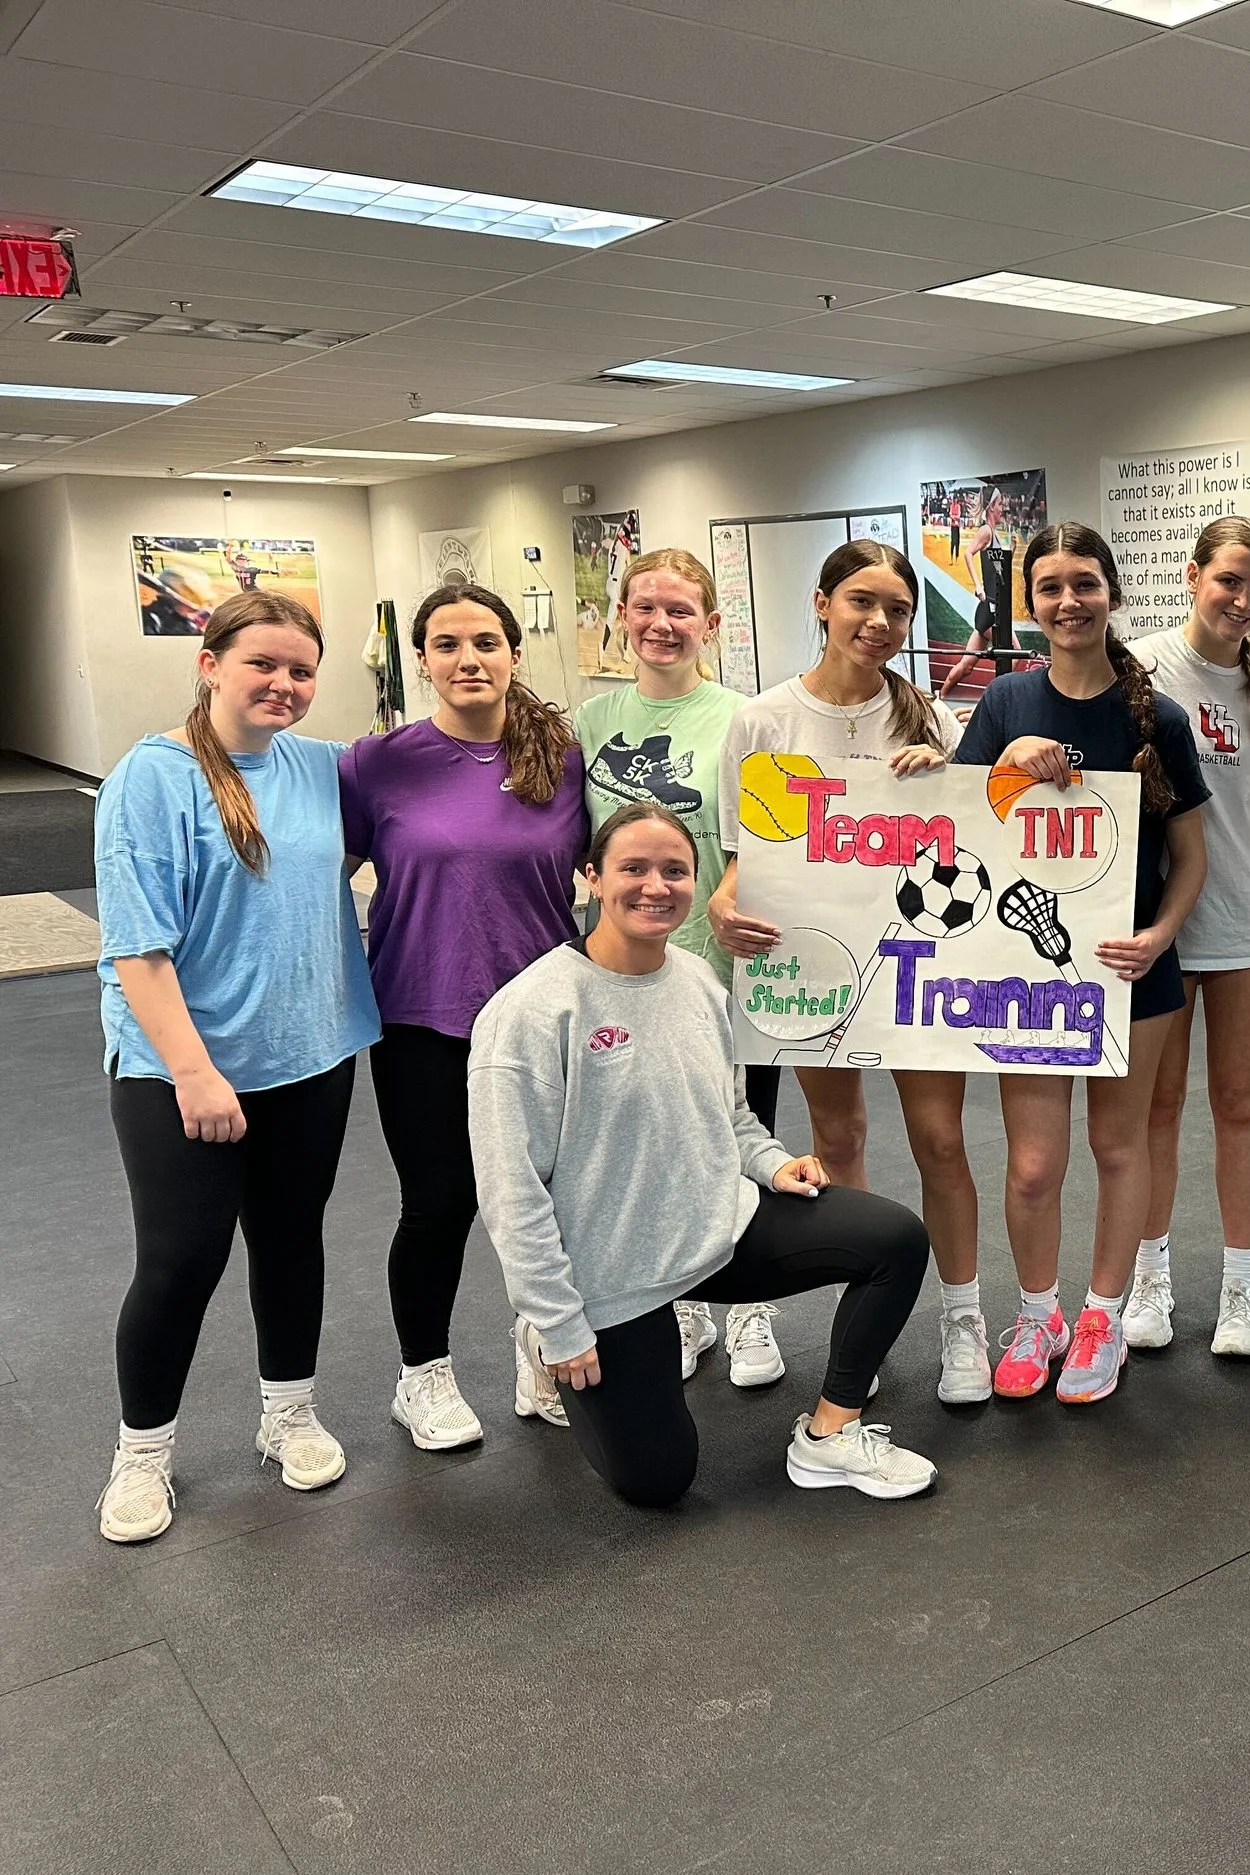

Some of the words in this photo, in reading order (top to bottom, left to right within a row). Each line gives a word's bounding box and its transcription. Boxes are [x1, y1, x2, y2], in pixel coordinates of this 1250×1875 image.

[1118, 462, 1149, 479] What
[1153, 458, 1175, 476] this
[1179, 456, 1218, 477] power
[1222, 453, 1232, 469] is
[1236, 451, 1239, 467] I
[1108, 484, 1148, 501] cannot
[1152, 484, 1174, 500] say;
[1178, 478, 1192, 495] all
[1196, 478, 1199, 494] I
[1203, 476, 1238, 493] know
[1123, 506, 1147, 522] that
[1150, 505, 1158, 521] it
[1162, 503, 1195, 520] exists
[1199, 498, 1222, 516] and
[1227, 499, 1235, 515] it
[1111, 528, 1162, 544] becomes
[1166, 523, 1205, 541] availa
[987, 549, 1005, 560] R12
[1116, 549, 1147, 565] when
[1151, 553, 1158, 564] a
[1161, 551, 1187, 563] man
[1137, 569, 1149, 585] of
[1153, 568, 1182, 585] mind
[1154, 591, 1195, 609] exactly
[1130, 613, 1164, 628] wants
[1168, 612, 1189, 628] and
[631, 754, 660, 773] CK
[622, 767, 651, 786] 5K
[786, 777, 955, 867] Team
[1015, 807, 1103, 859] TNT
[746, 953, 801, 980] Just
[746, 983, 852, 1016] Started!
[879, 939, 1105, 1066] Training
